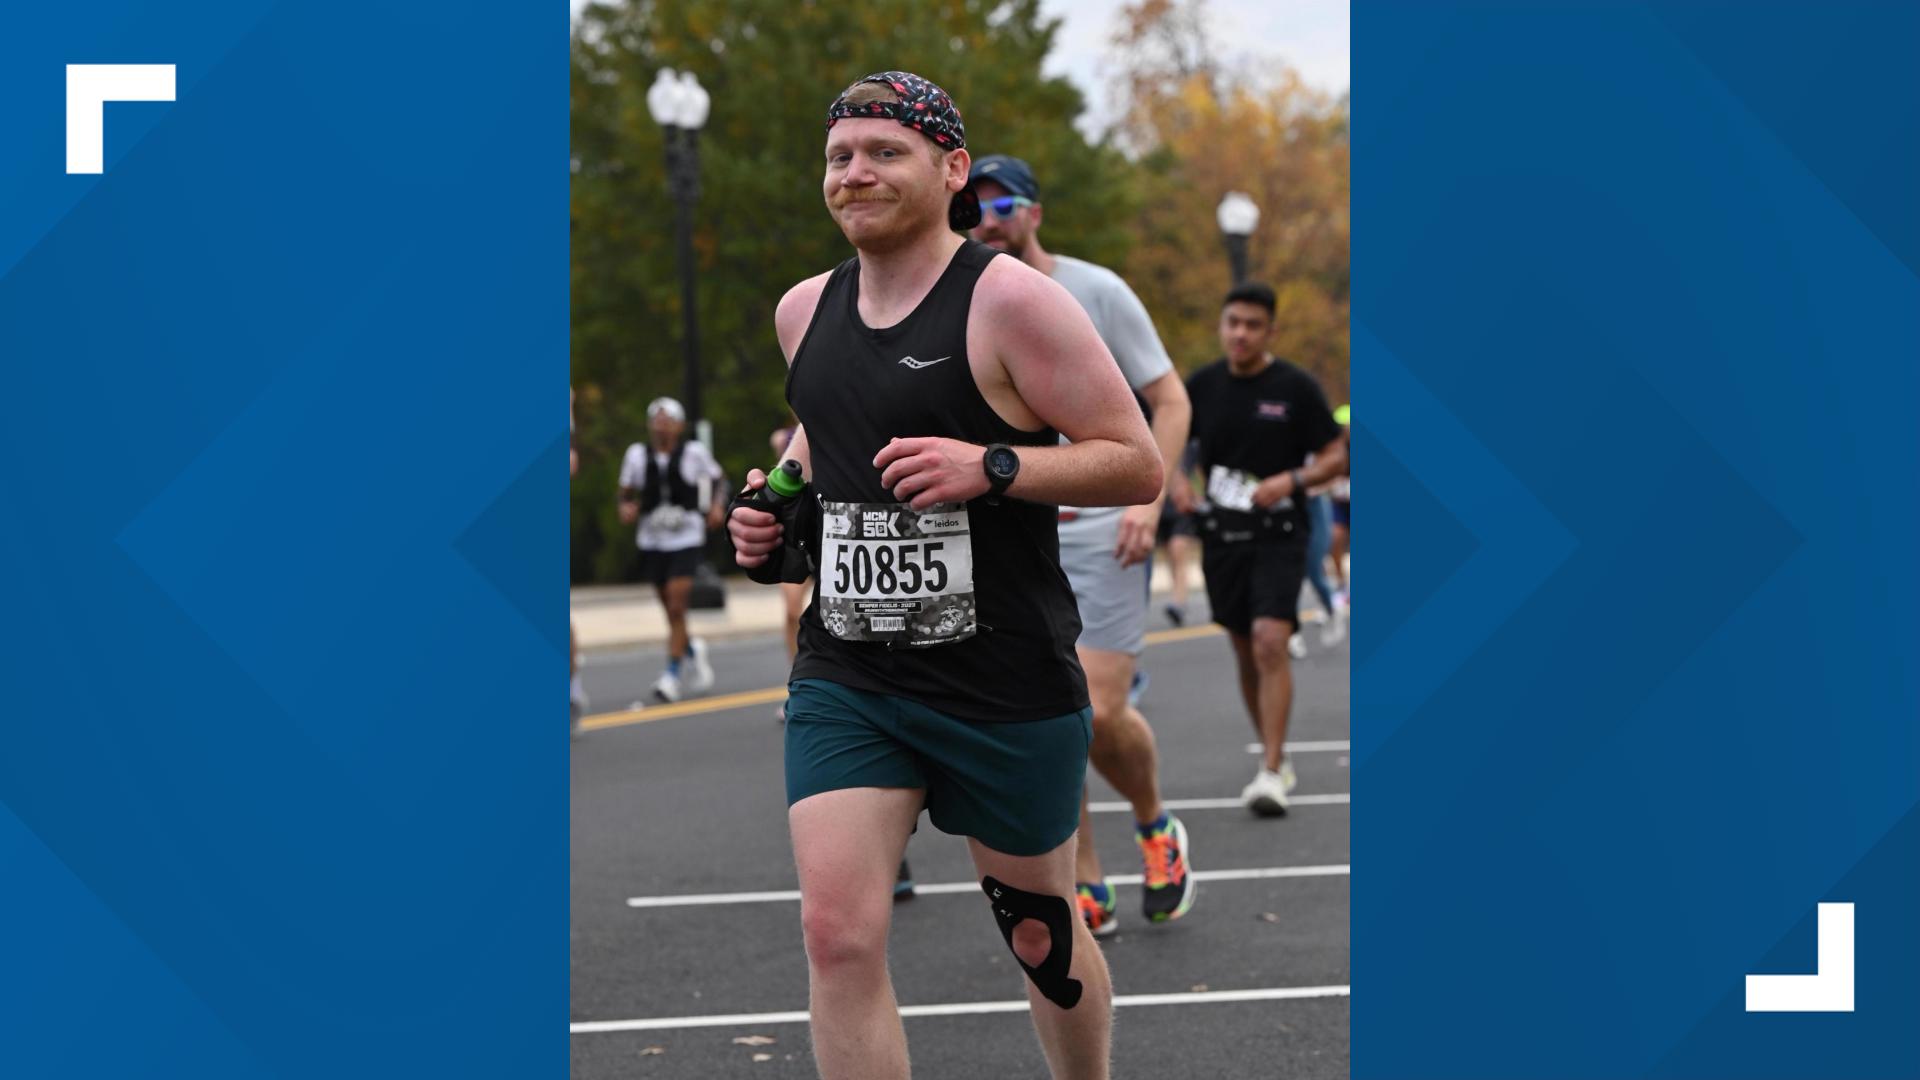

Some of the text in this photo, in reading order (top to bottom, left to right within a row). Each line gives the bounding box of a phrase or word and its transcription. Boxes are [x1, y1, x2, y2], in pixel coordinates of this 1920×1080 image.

[863, 511, 888, 521] MCM
[934, 519, 960, 528] leidos
[834, 542, 948, 594] 50855
